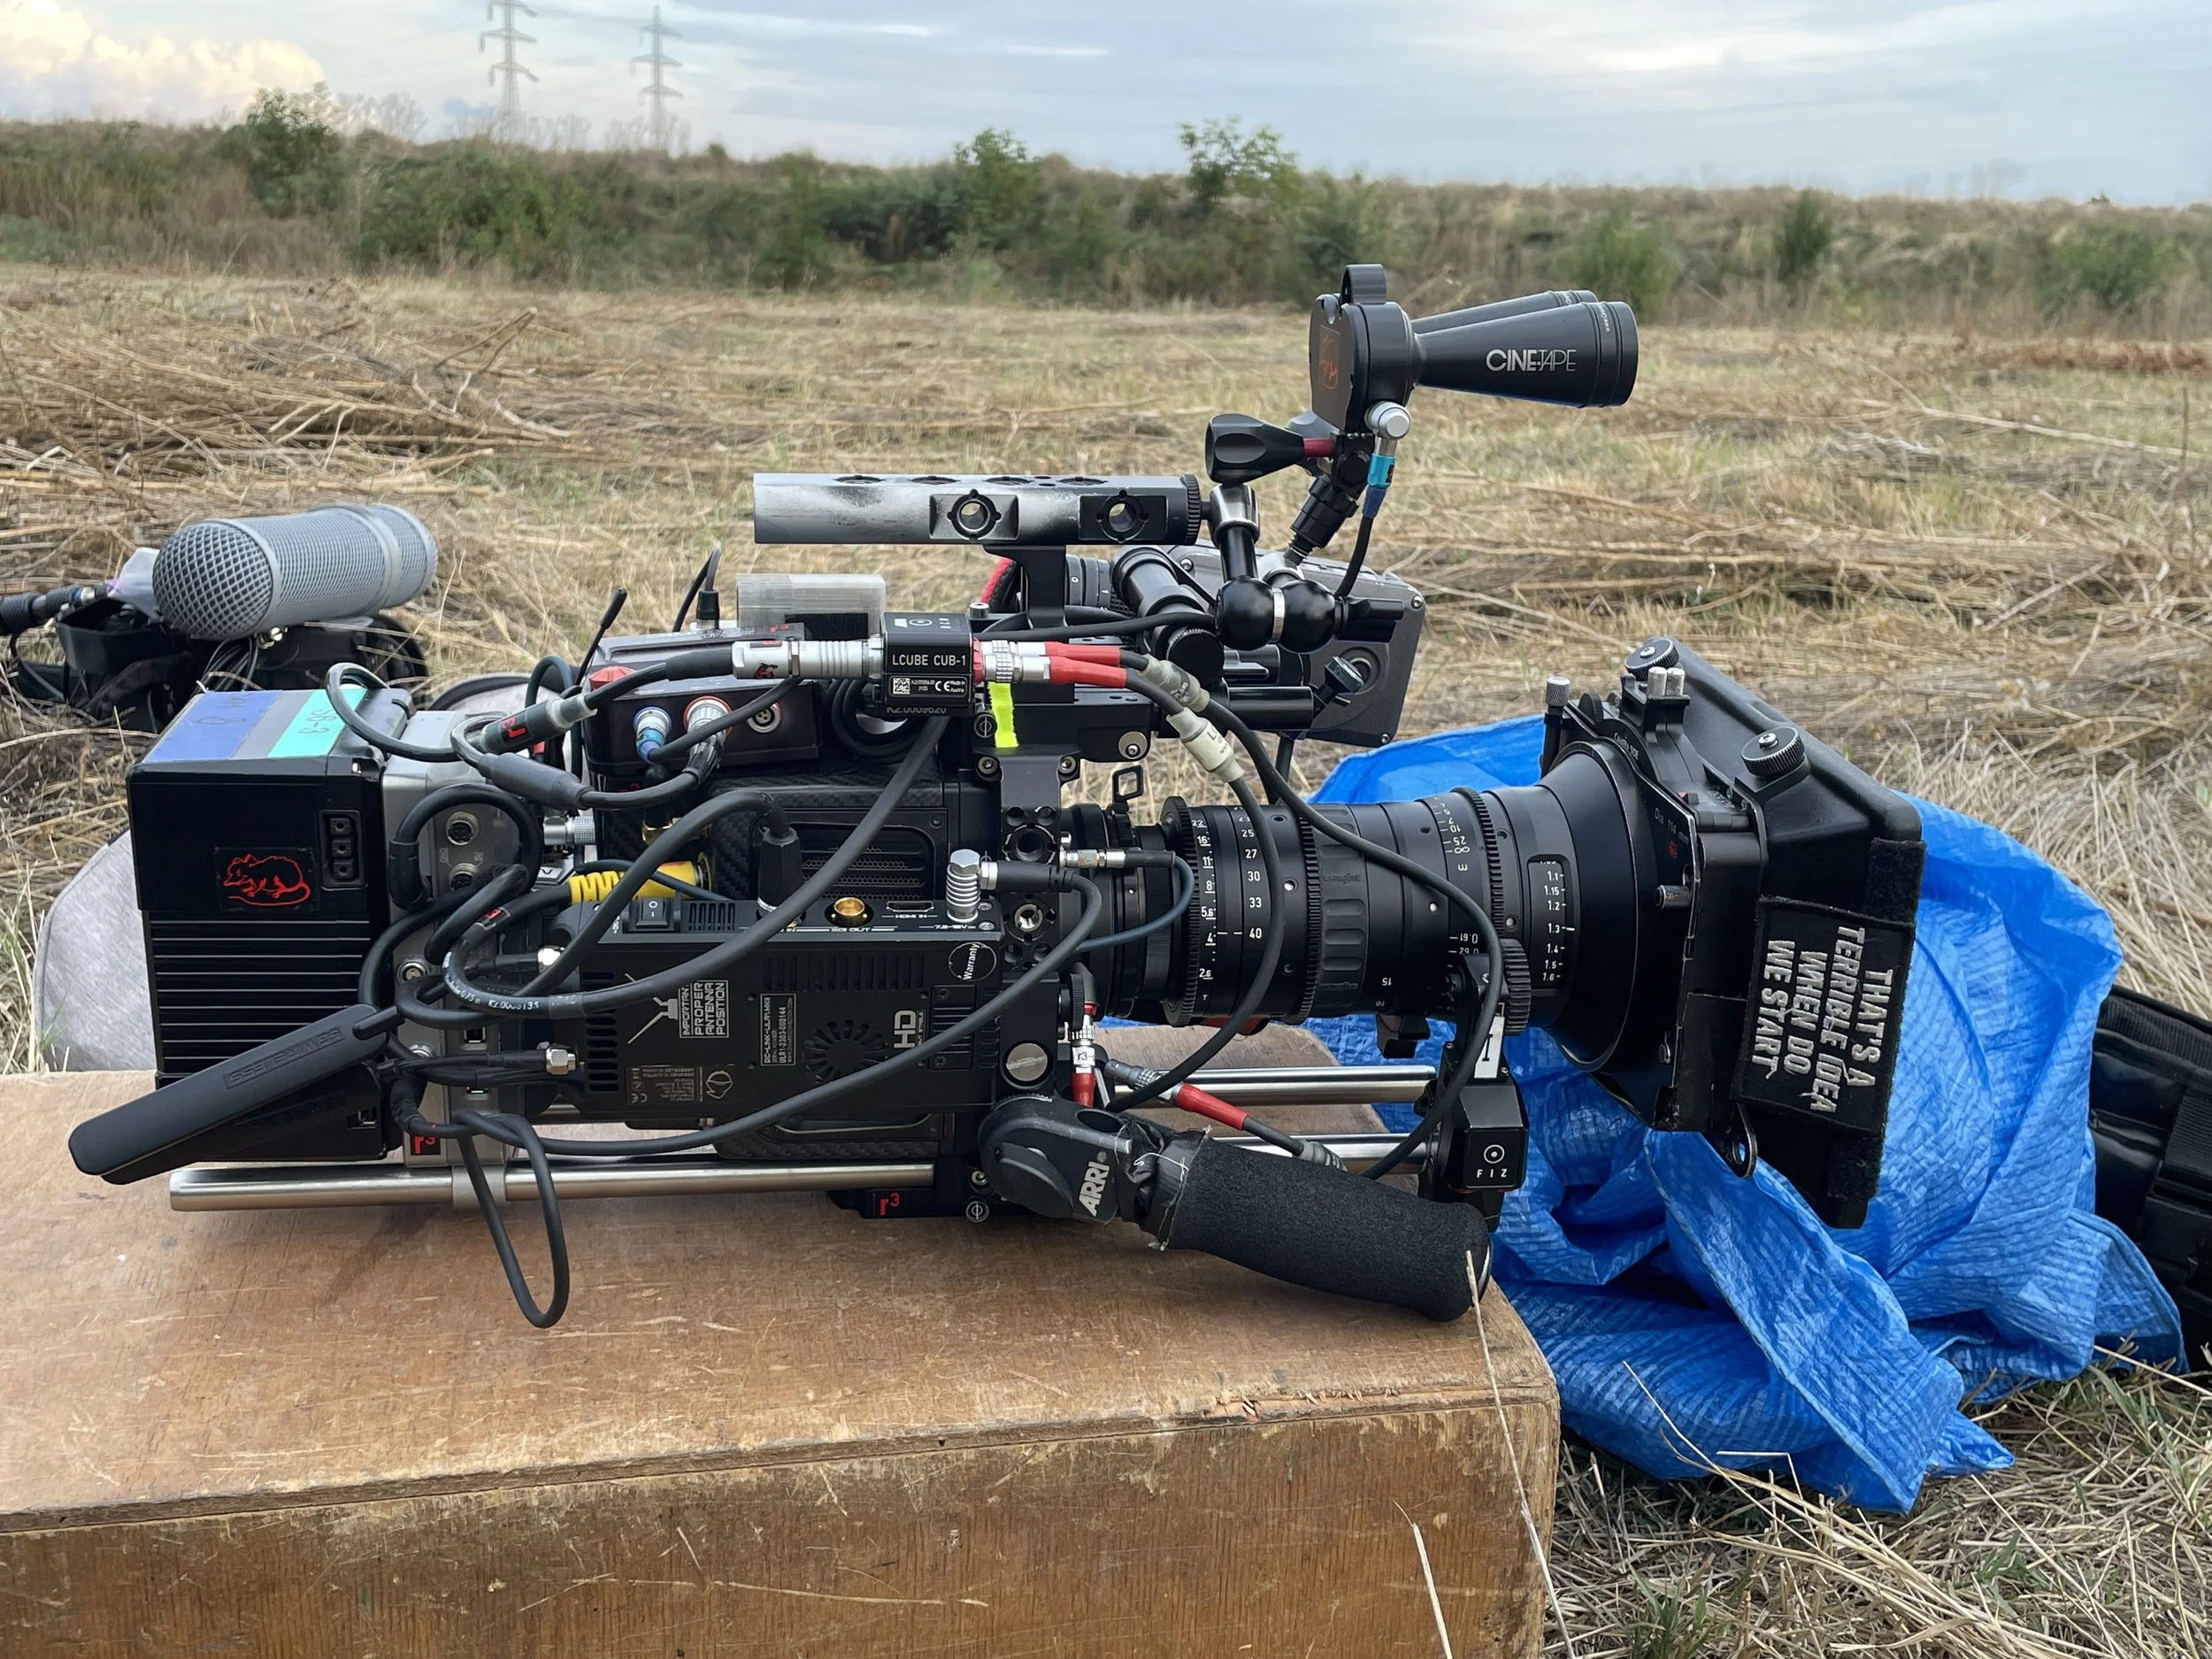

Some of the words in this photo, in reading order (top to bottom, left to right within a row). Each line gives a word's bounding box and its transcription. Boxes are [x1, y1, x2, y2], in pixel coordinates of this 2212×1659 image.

[892, 654, 929, 666] LCUBE
[933, 654, 966, 666] CUB-1
[1449, 824, 1462, 833] 10
[1196, 835, 1208, 844] 16
[1453, 835, 1467, 846] 25
[1245, 849, 1257, 858] 27
[1202, 856, 1211, 866] 11
[1247, 871, 1261, 881] 30
[1547, 870, 1558, 881] 1.1
[1205, 879, 1212, 891] 8
[1544, 885, 1560, 895] 1.15
[1248, 896, 1262, 908] 33
[1548, 899, 1560, 910] 1.2
[1201, 906, 1214, 917] 5.6
[1248, 927, 1263, 939] 40
[1548, 922, 1560, 934] 1.3
[1207, 932, 1213, 943] 4
[1460, 933, 1479, 944] 0.61
[1547, 943, 1559, 954] 1.4
[962, 943, 980, 980] Warranty
[1544, 959, 1556, 970] 1.5
[1763, 940, 1795, 983] WE
[1199, 968, 1211, 978] 2.6
[1543, 972, 1555, 981] 1.6
[1382, 977, 1392, 987] 15
[1820, 926, 1866, 1050] TERRIBLE
[1790, 951, 1828, 1031] WHEN
[693, 982, 704, 1035] PROPER
[704, 982, 715, 1035] ANTENNA
[715, 982, 726, 1035] POSITION
[1851, 969, 1893, 1063] THAT'S
[893, 1010, 917, 1048] HD
[1751, 987, 1789, 1072] START
[1784, 1035, 1815, 1075] DO
[1809, 1053, 1844, 1113] IDEA
[1847, 1067, 1876, 1087] A
[1079, 1161, 1110, 1217] ARRI
